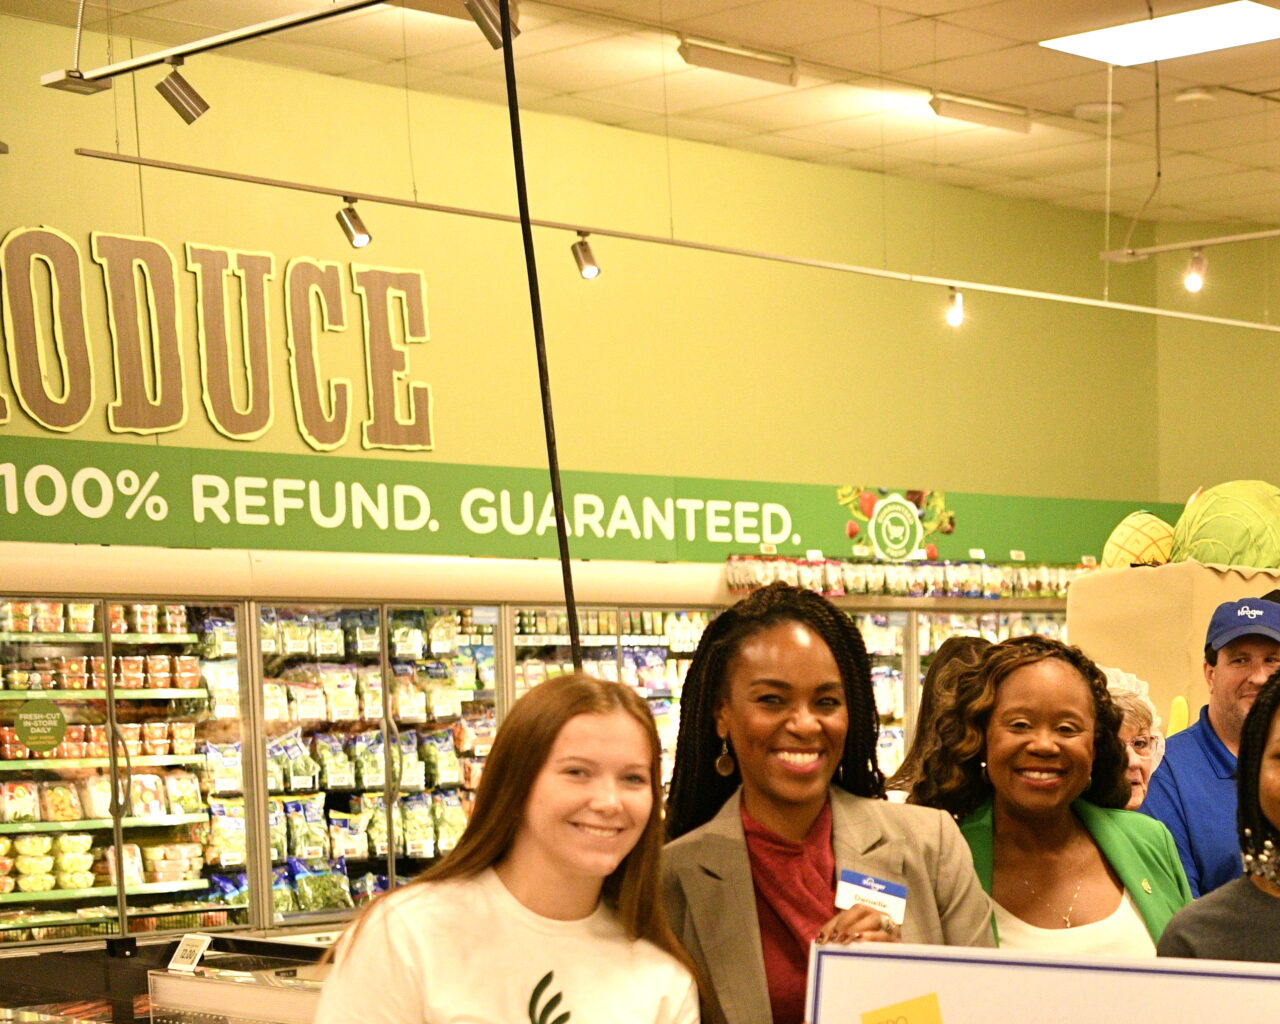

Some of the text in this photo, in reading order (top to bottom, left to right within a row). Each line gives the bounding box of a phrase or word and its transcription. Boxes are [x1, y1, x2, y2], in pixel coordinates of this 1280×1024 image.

[0, 225, 436, 453] ODUCE
[0, 462, 802, 545] 100% REFUND. GUARANTEED.
[1237, 605, 1264, 619] Kroger
[19, 712, 61, 720] FRESH-CUT
